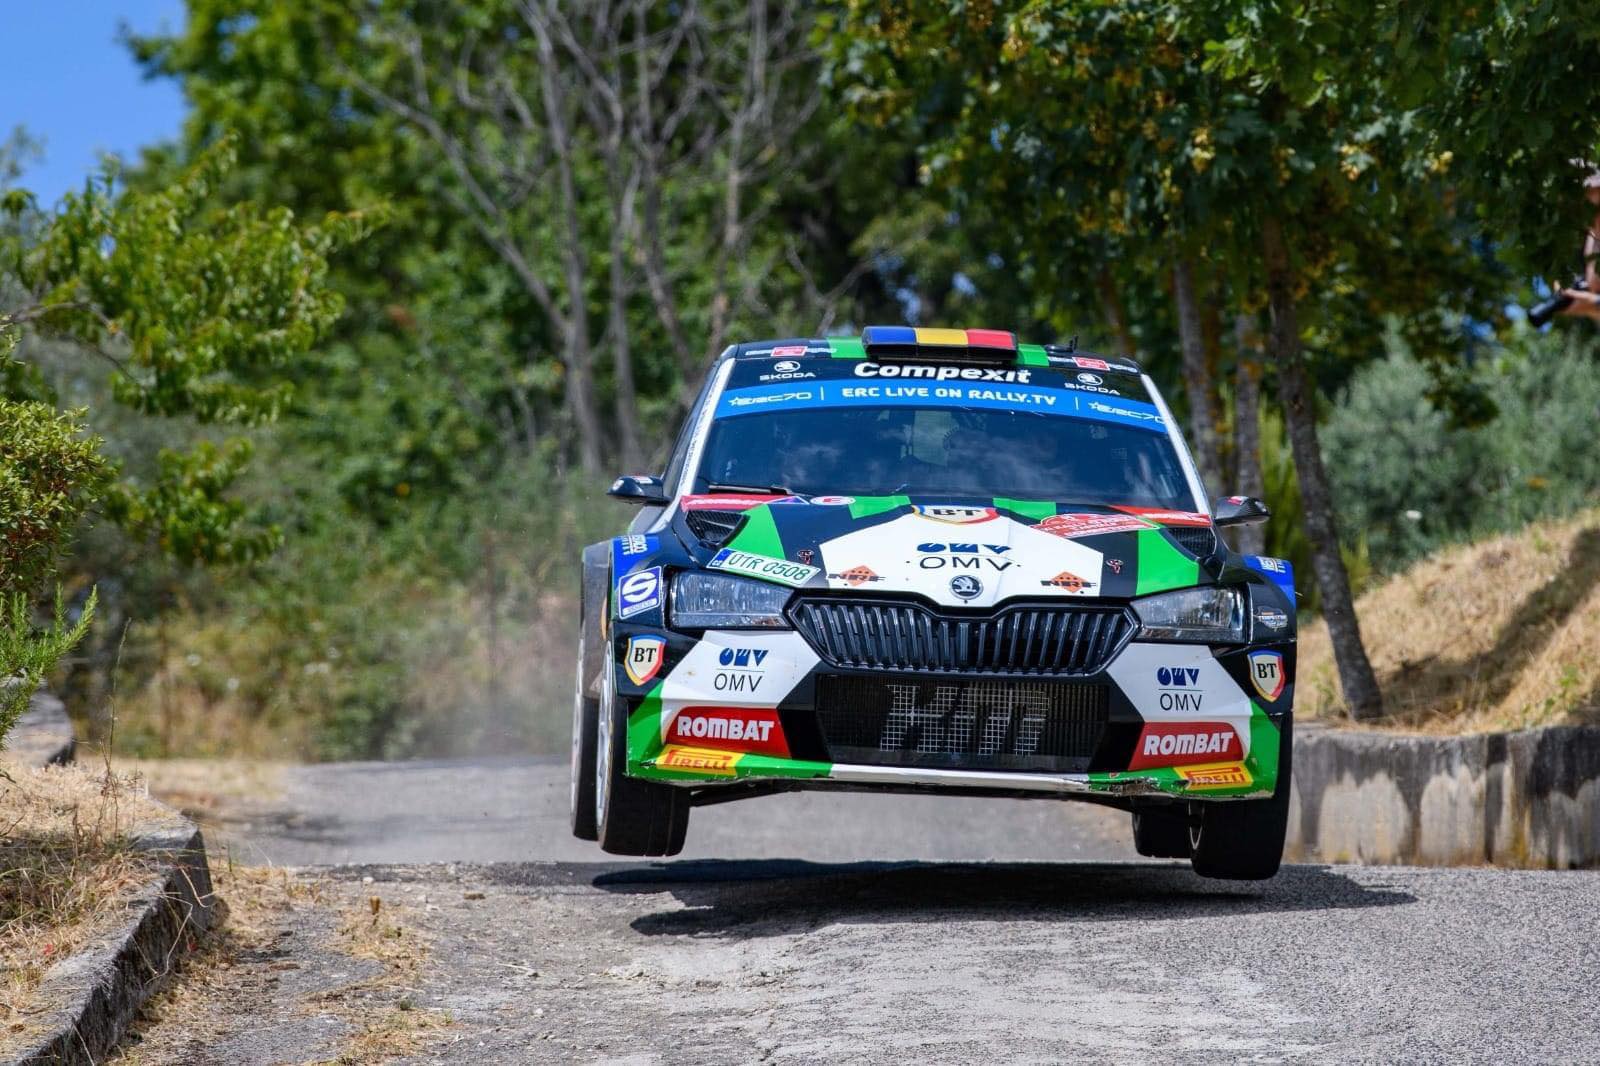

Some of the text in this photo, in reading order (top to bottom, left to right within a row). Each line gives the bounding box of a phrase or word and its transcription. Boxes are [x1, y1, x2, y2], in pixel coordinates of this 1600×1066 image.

[854, 362, 1032, 384] Compexit
[842, 387, 1056, 405] ERC LIVE ON RALLY.TV
[762, 559, 811, 581] 0508
[919, 556, 1013, 571] OMV
[634, 647, 657, 663] BT
[1256, 663, 1277, 679] BT
[714, 672, 763, 692] OMV
[1159, 693, 1203, 711] OMV
[677, 715, 775, 742] ROMBAT
[1143, 732, 1234, 756] ROMBAT
[664, 749, 733, 770] PIRELLI
[1184, 766, 1245, 785] PIRELLI
